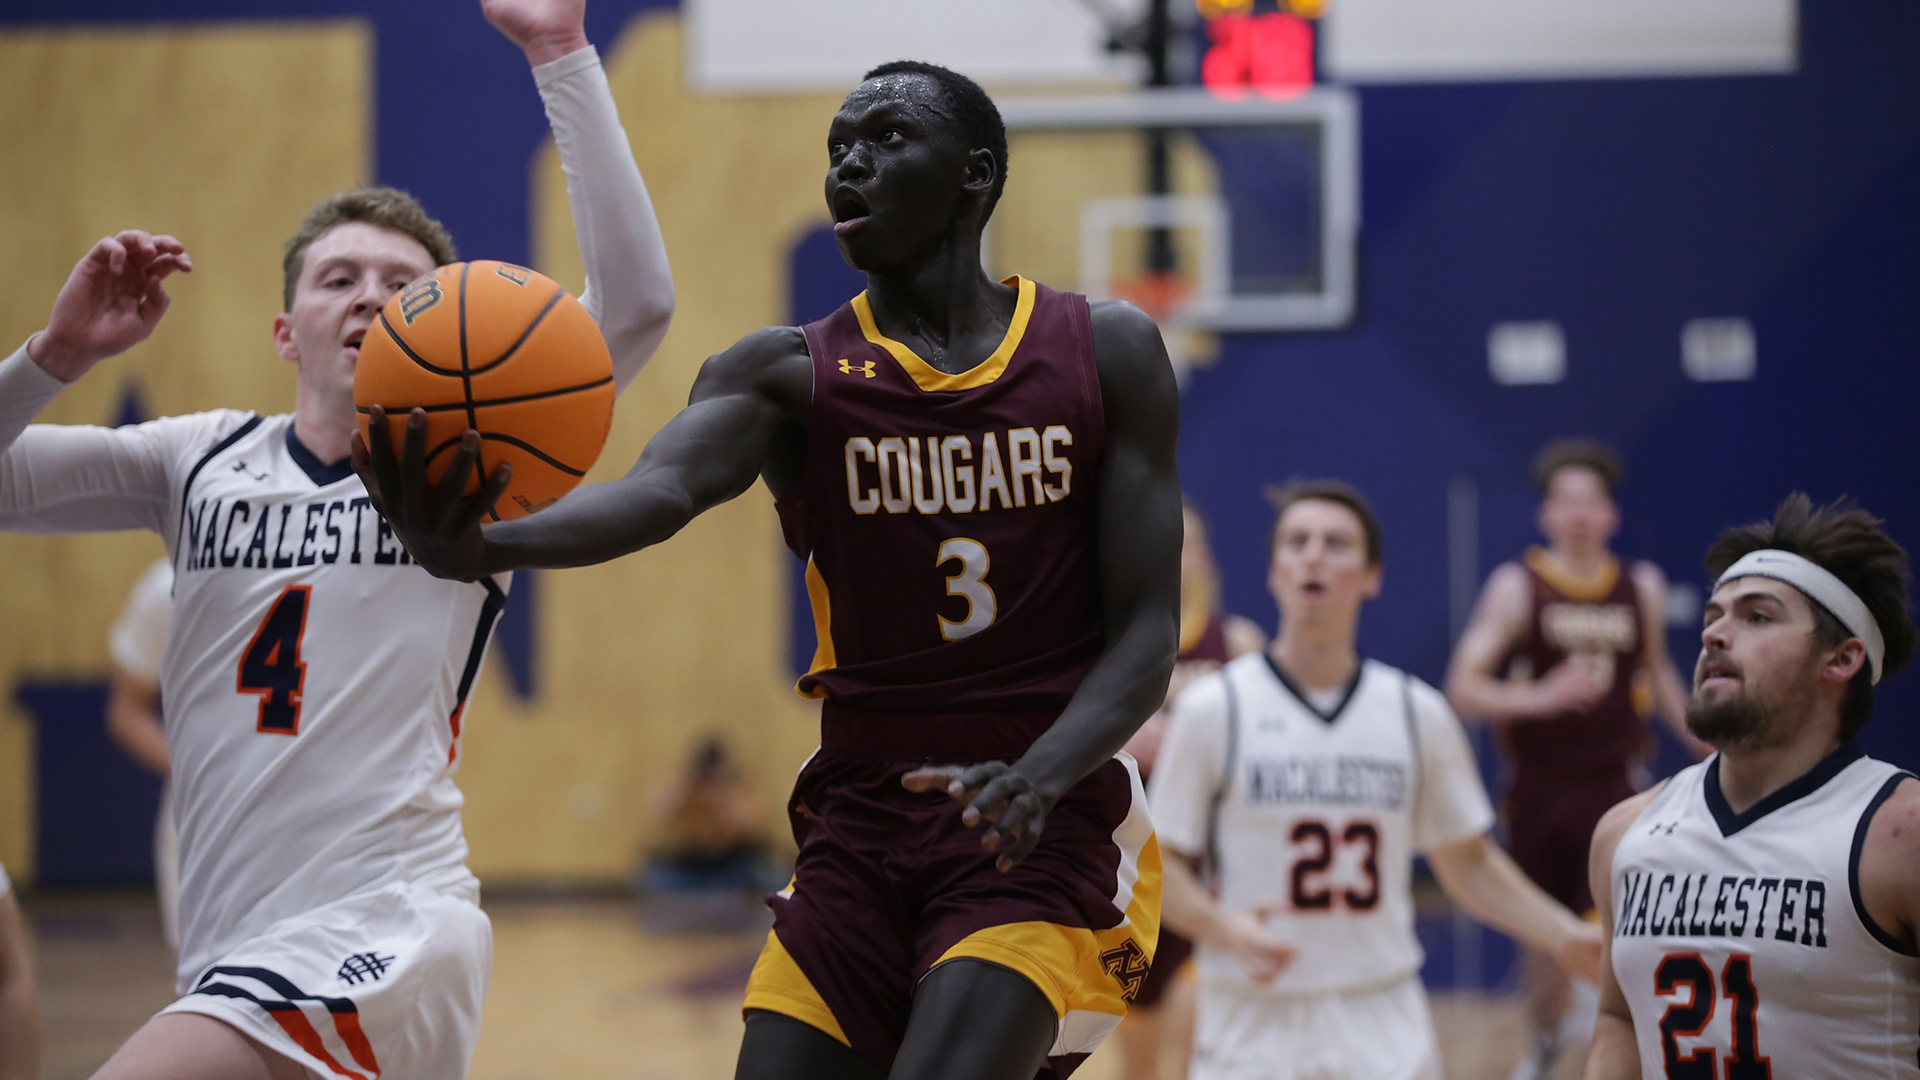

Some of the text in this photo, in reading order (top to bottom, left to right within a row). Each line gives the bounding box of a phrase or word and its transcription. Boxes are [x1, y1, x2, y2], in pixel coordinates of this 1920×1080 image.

[844, 424, 1073, 515] COUGARS
[935, 536, 998, 642] 3
[236, 583, 313, 736] 4
[1288, 820, 1380, 911] 23
[1615, 871, 1828, 948] MACALESTER
[1653, 952, 1774, 1080] 21
